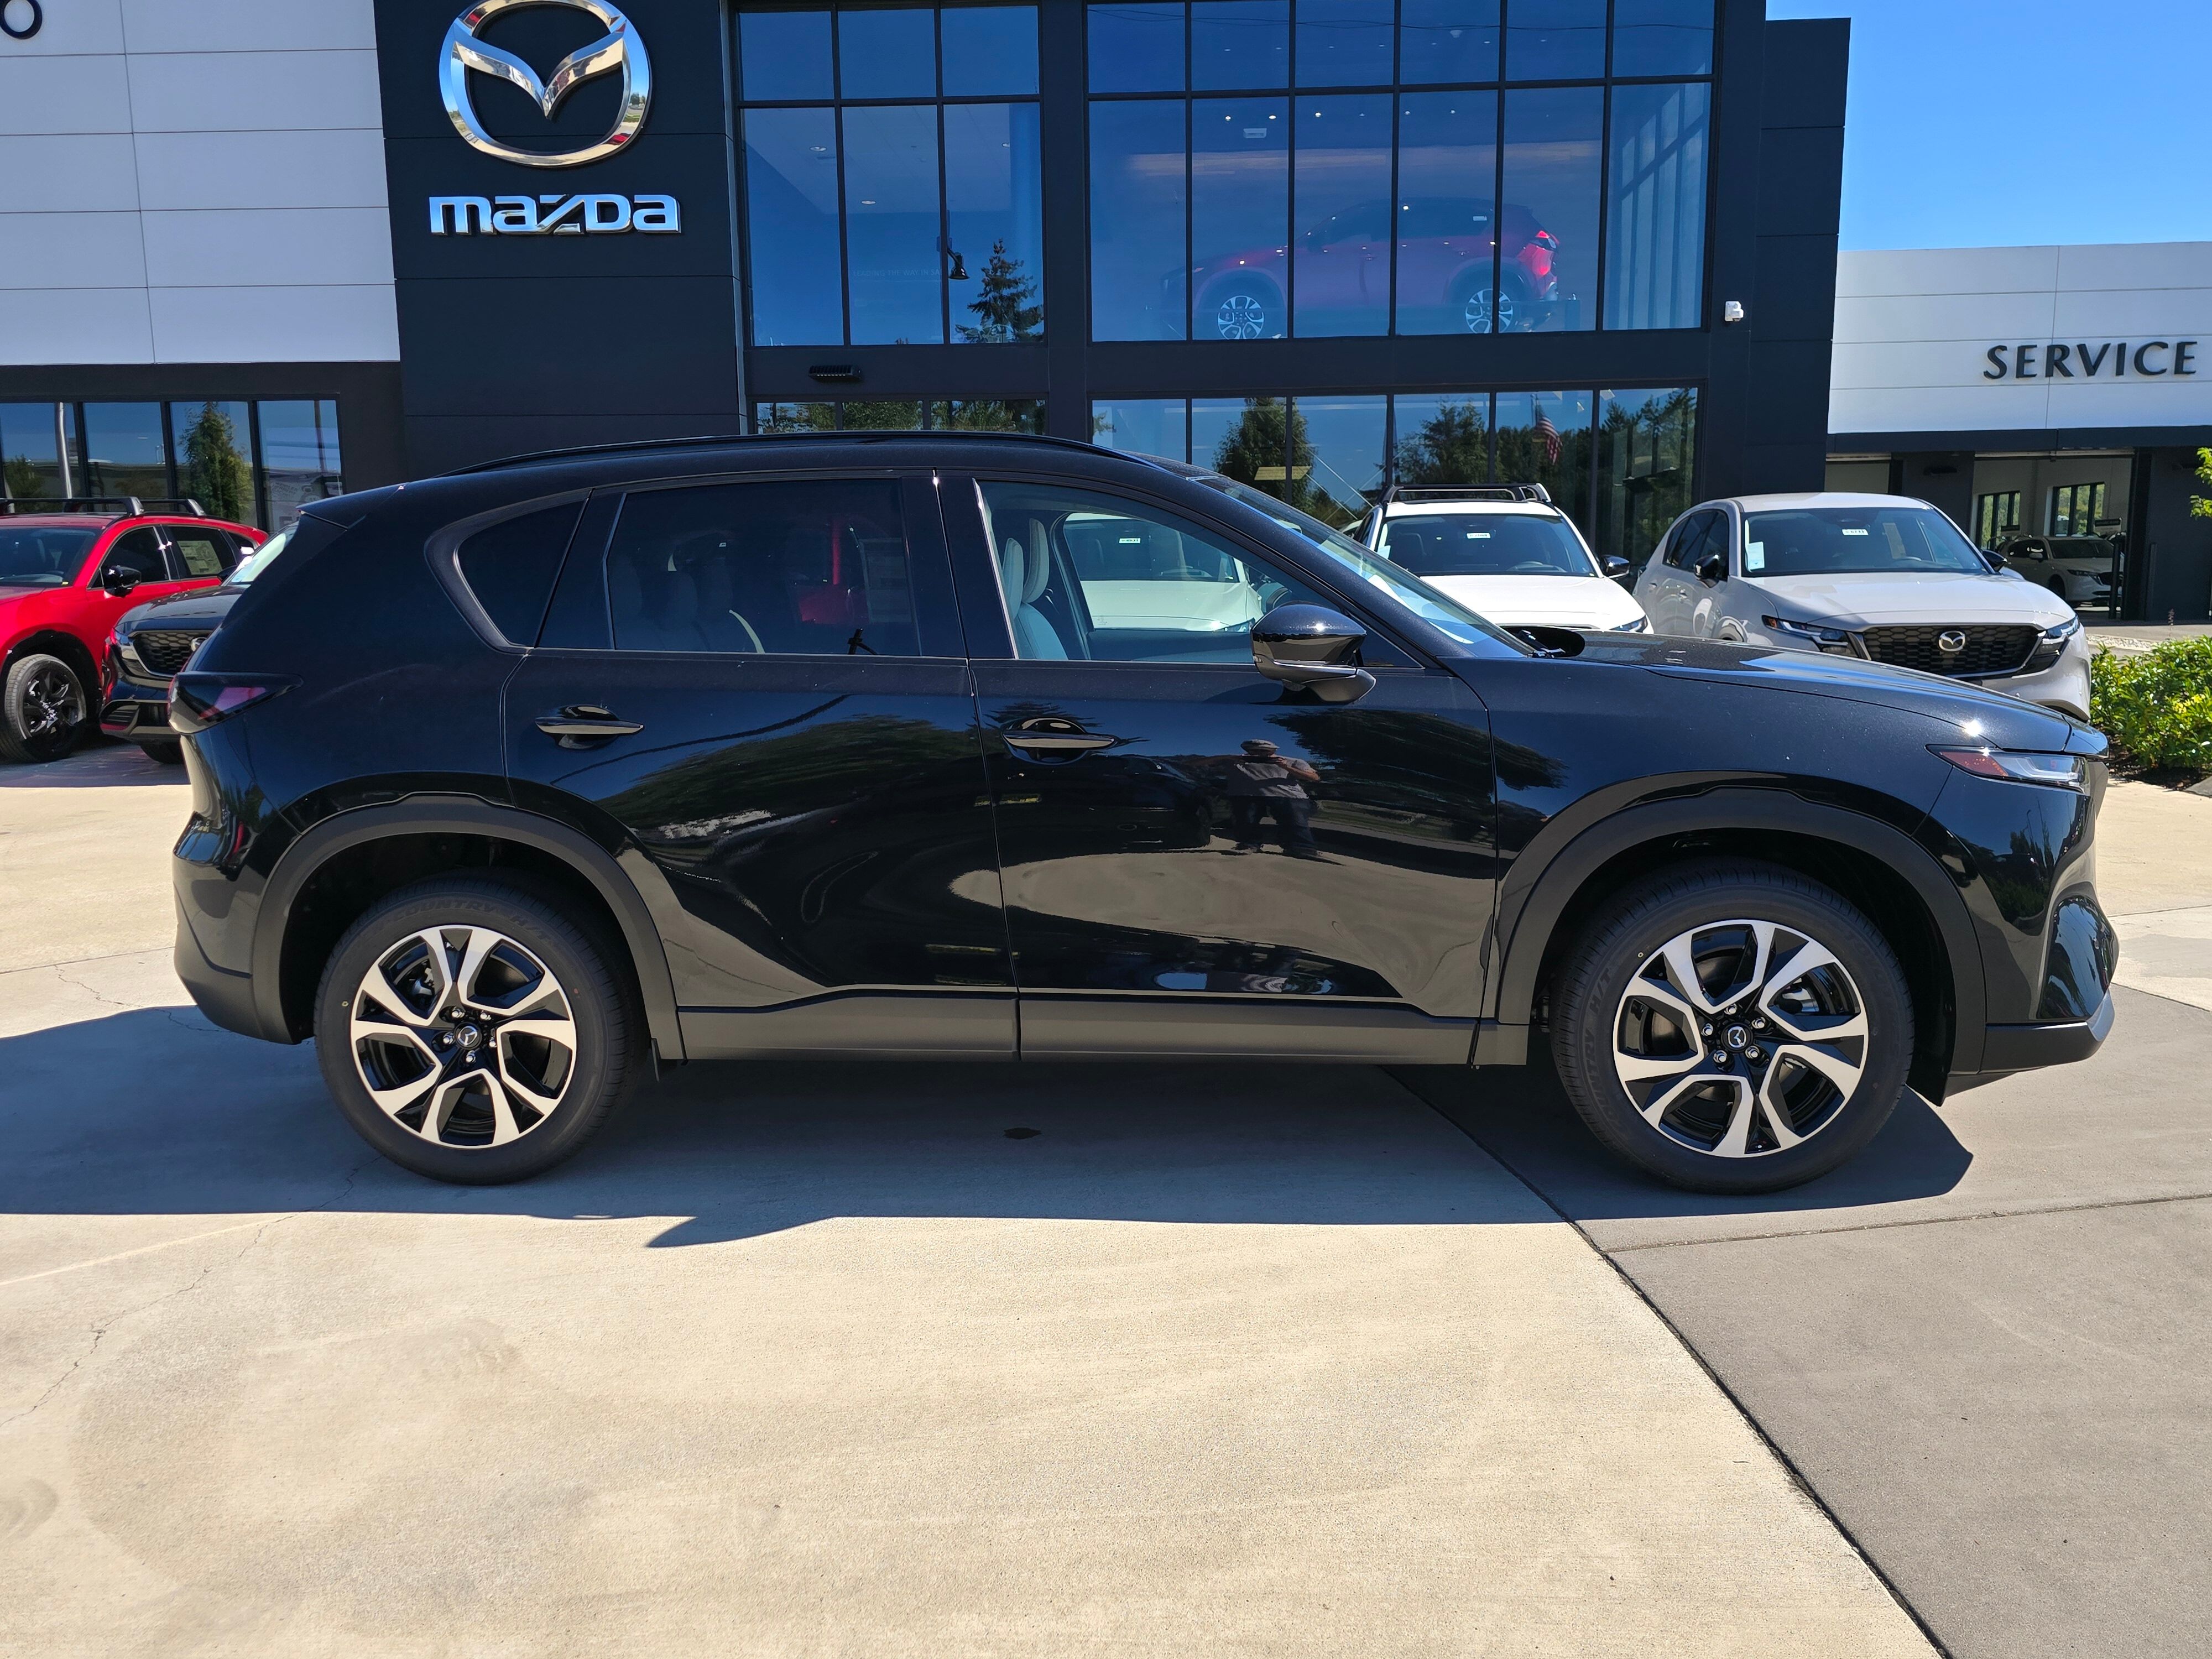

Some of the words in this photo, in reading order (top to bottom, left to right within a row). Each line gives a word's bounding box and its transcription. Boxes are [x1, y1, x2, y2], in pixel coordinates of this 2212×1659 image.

[1984, 341, 2197, 379] SERVICE
[390, 899, 498, 922] COUNTRY
[1589, 967, 1611, 1015] H/T
